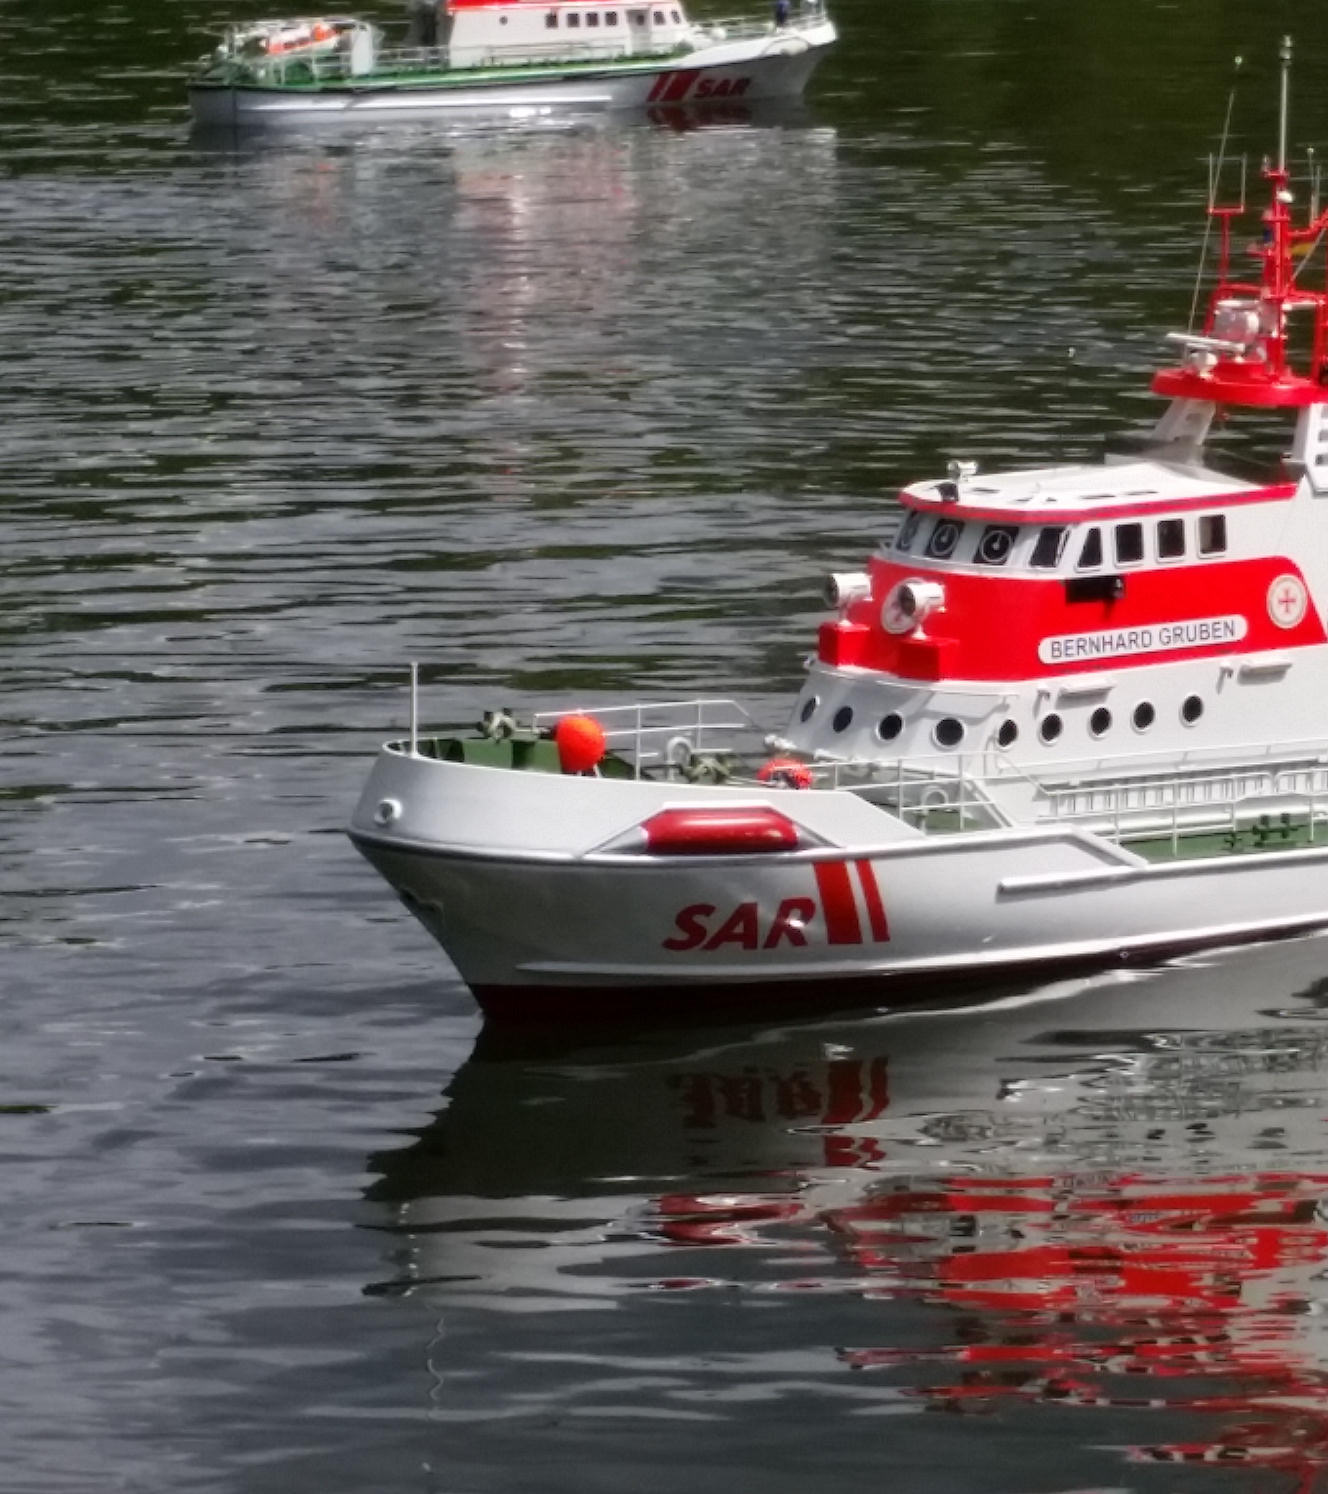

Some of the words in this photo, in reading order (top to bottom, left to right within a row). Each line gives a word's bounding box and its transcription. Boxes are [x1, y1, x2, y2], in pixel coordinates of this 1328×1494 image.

[694, 78, 751, 98] SAR
[1051, 630, 1152, 660] BERNHARD
[1159, 620, 1235, 646] GRUBEN
[662, 897, 816, 951] SAR
